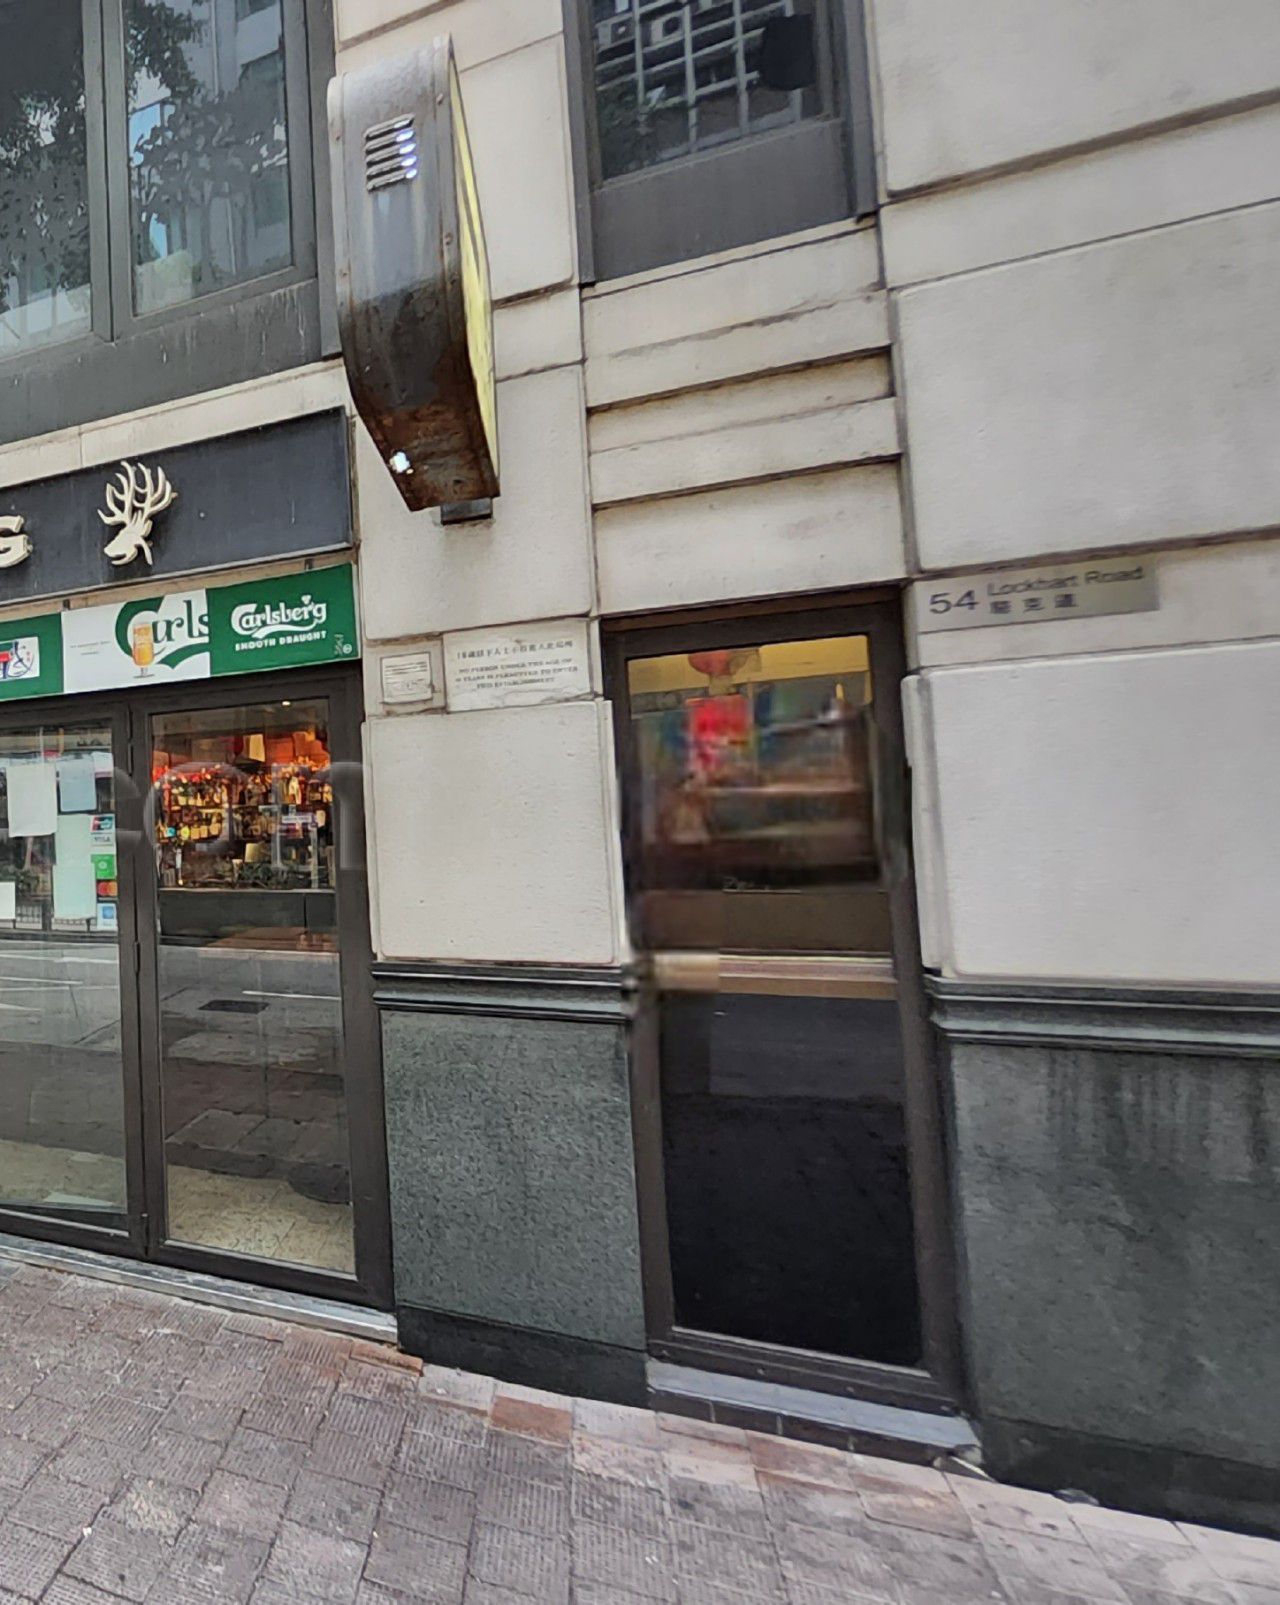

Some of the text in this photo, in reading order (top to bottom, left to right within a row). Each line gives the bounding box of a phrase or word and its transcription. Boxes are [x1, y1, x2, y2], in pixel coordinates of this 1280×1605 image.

[1085, 566, 1145, 584] Road
[929, 590, 980, 614] 54
[231, 595, 327, 638] Carlsberg
